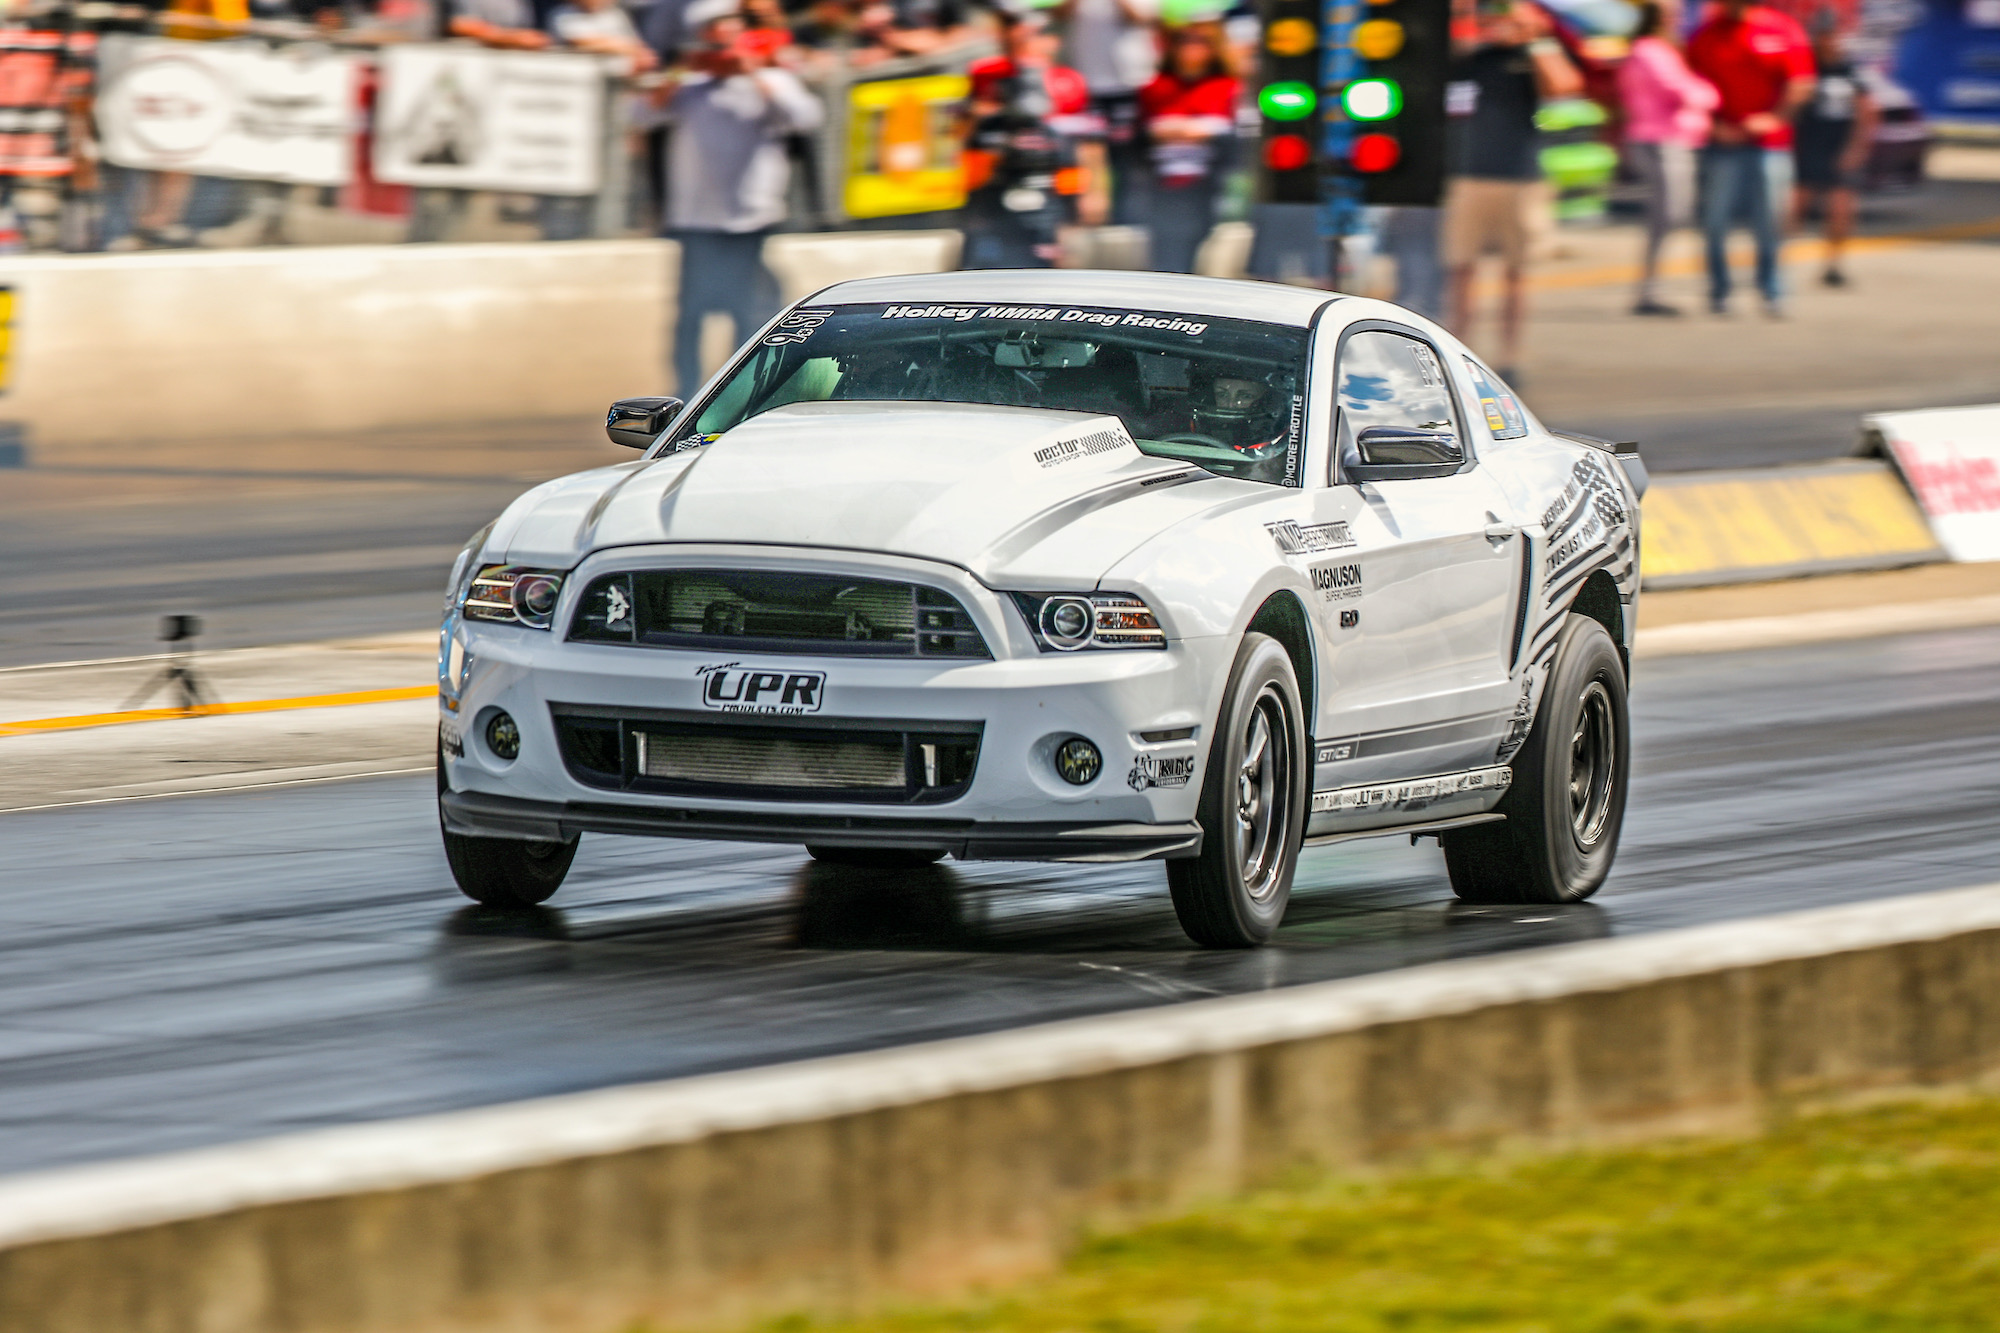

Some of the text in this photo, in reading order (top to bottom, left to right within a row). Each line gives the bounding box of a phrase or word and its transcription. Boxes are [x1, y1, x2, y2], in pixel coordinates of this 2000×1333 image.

[881, 305, 1209, 336] Holley NMRA Drag Racing
[1033, 439, 1079, 463] vector
[1281, 394, 1303, 487] @MOORETHROTTLE
[1309, 563, 1362, 591] MAGNUSON
[708, 671, 820, 705] UPR
